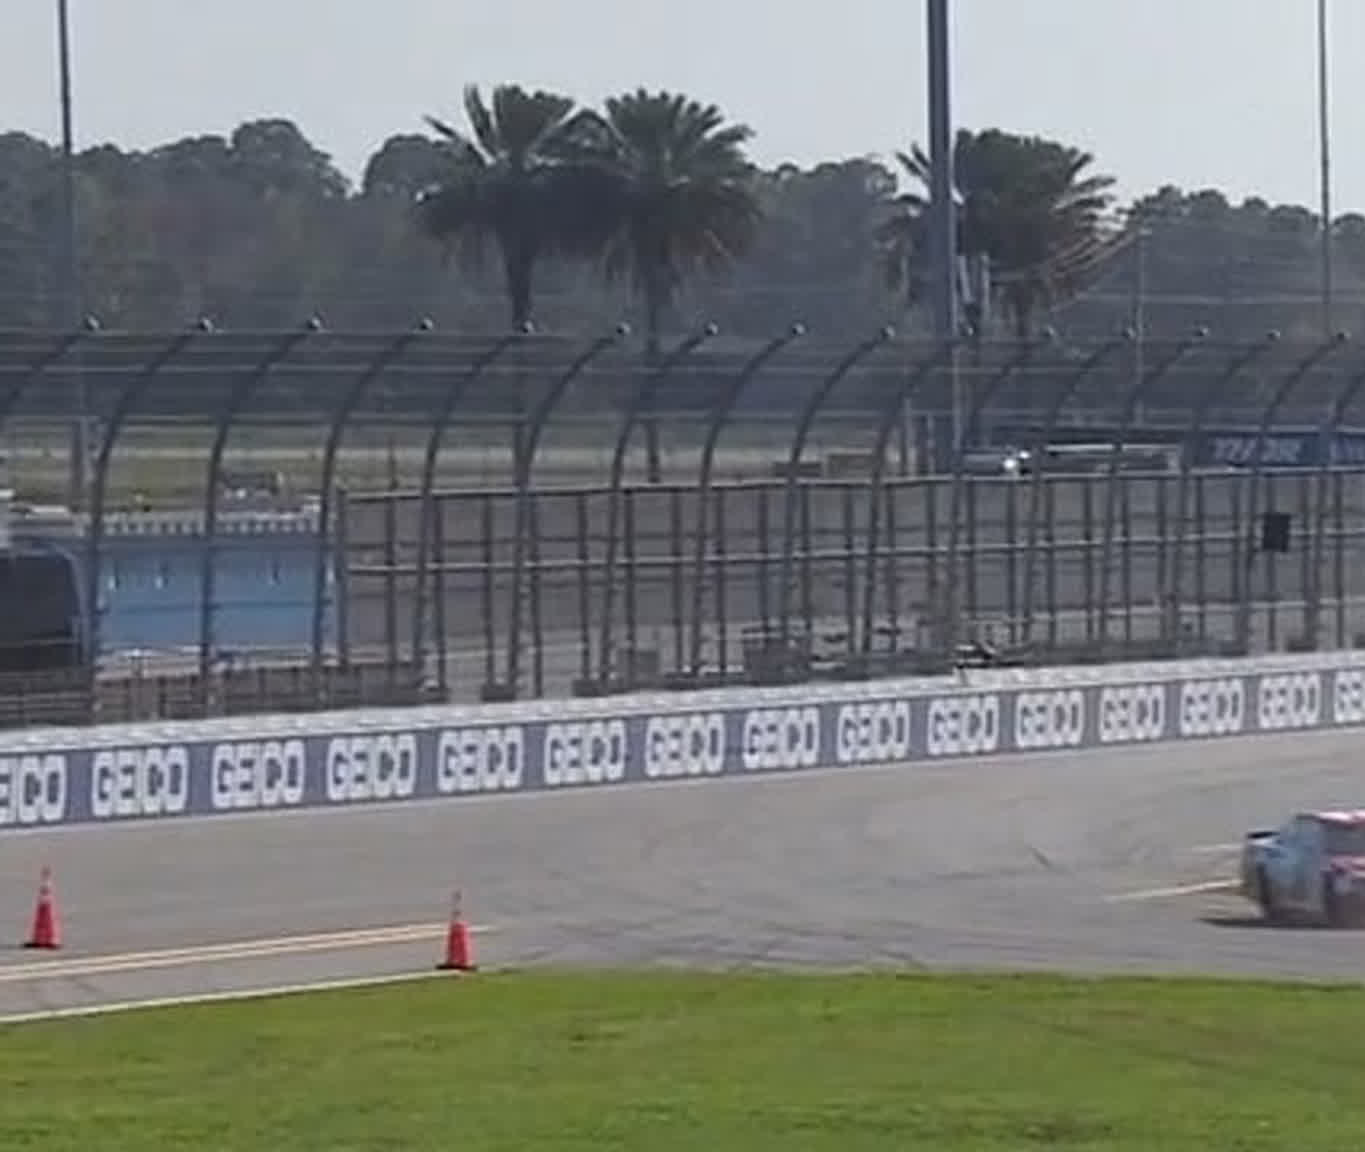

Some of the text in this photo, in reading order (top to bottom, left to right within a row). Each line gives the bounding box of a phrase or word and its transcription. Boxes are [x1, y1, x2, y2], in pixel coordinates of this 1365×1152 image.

[92, 746, 188, 817] GEICO
[212, 740, 304, 809] GEICO
[327, 733, 416, 800] GEICO
[437, 726, 524, 792] GEICO
[544, 719, 626, 785] GEICO
[645, 713, 725, 777] GEICO
[743, 707, 820, 770] GEICO
[837, 700, 909, 762] GEICO
[928, 696, 998, 755] GEICO
[1015, 689, 1085, 748] GEICO
[1100, 684, 1166, 743] GEICO
[1179, 679, 1244, 736] GEICO
